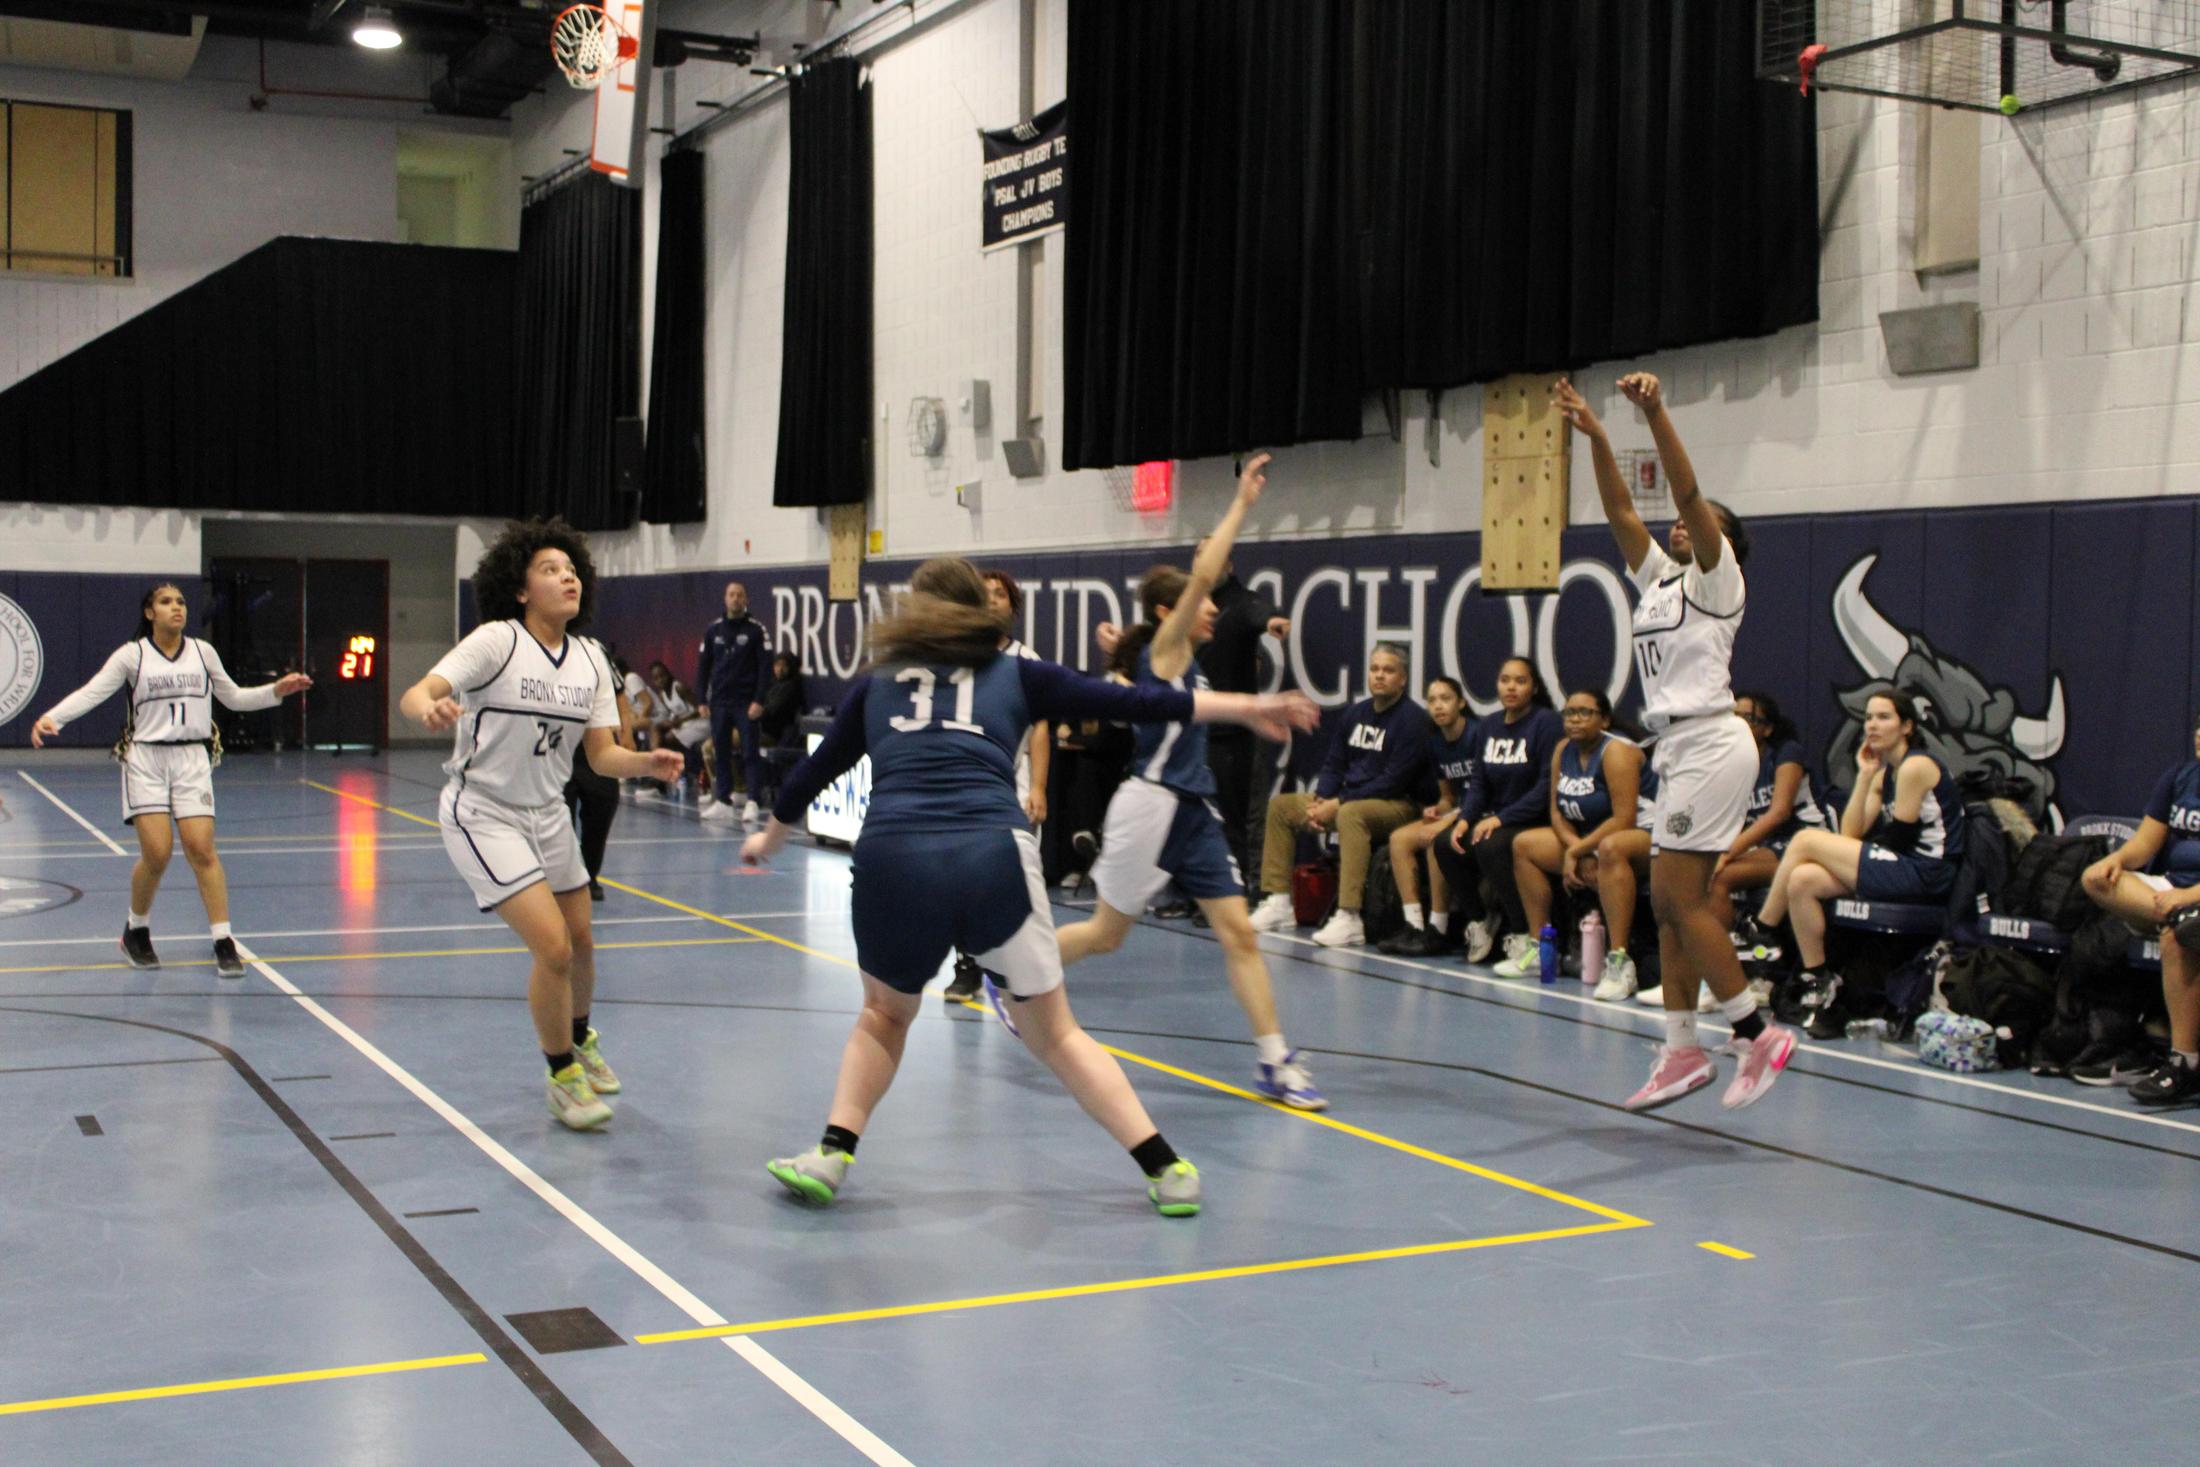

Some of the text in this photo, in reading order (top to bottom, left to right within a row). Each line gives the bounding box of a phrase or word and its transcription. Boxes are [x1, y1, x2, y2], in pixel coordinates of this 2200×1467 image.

[983, 135, 1067, 181] FOUNDING RUGBY TE
[994, 167, 1063, 207] PSAL JV BOYS
[1002, 200, 1054, 233] CHAMPIONS
[771, 583, 914, 679] BRON
[1247, 562, 1634, 717] SCHOO
[342, 653, 371, 678] 21
[1638, 640, 1662, 678] 10
[147, 673, 175, 692] BRONX
[520, 677, 557, 704] BRONX
[168, 702, 185, 726] 11
[889, 667, 985, 735] 31
[1483, 736, 1528, 764] ACLA
[1441, 760, 1474, 779] AGLE
[2081, 821, 2111, 836] BRONX
[2169, 804, 2200, 833] EAG
[1835, 899, 1870, 920] BULLS
[1990, 917, 2031, 940] BULLS
